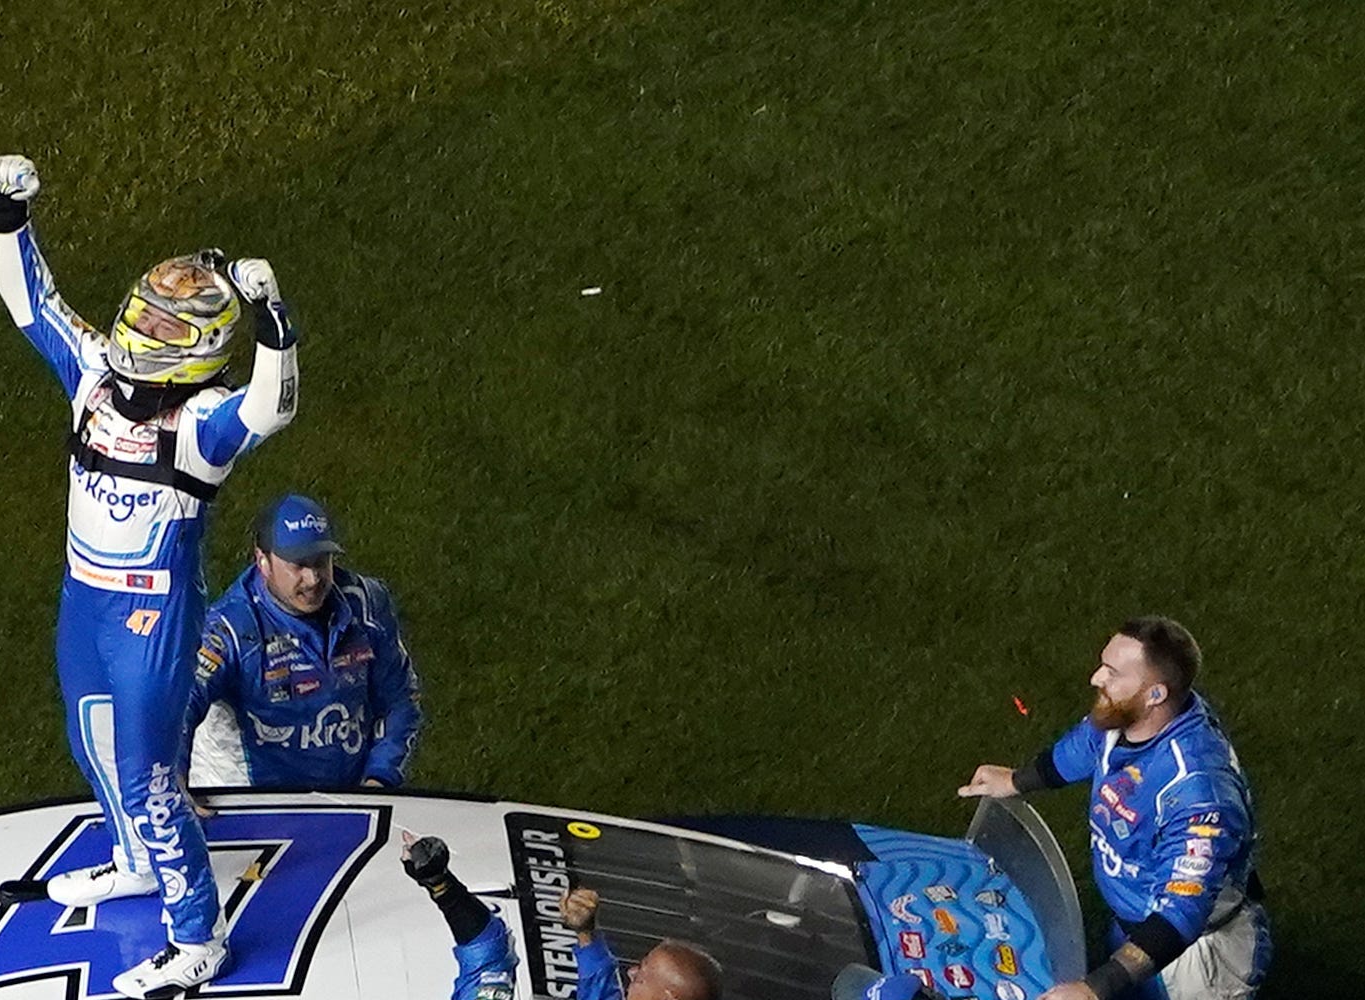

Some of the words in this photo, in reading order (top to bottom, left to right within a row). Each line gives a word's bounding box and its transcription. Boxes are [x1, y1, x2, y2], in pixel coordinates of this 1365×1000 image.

[85, 472, 163, 522] Kroger
[126, 608, 161, 637] 47
[134, 762, 184, 862] Kroger
[522, 829, 565, 857] JR
